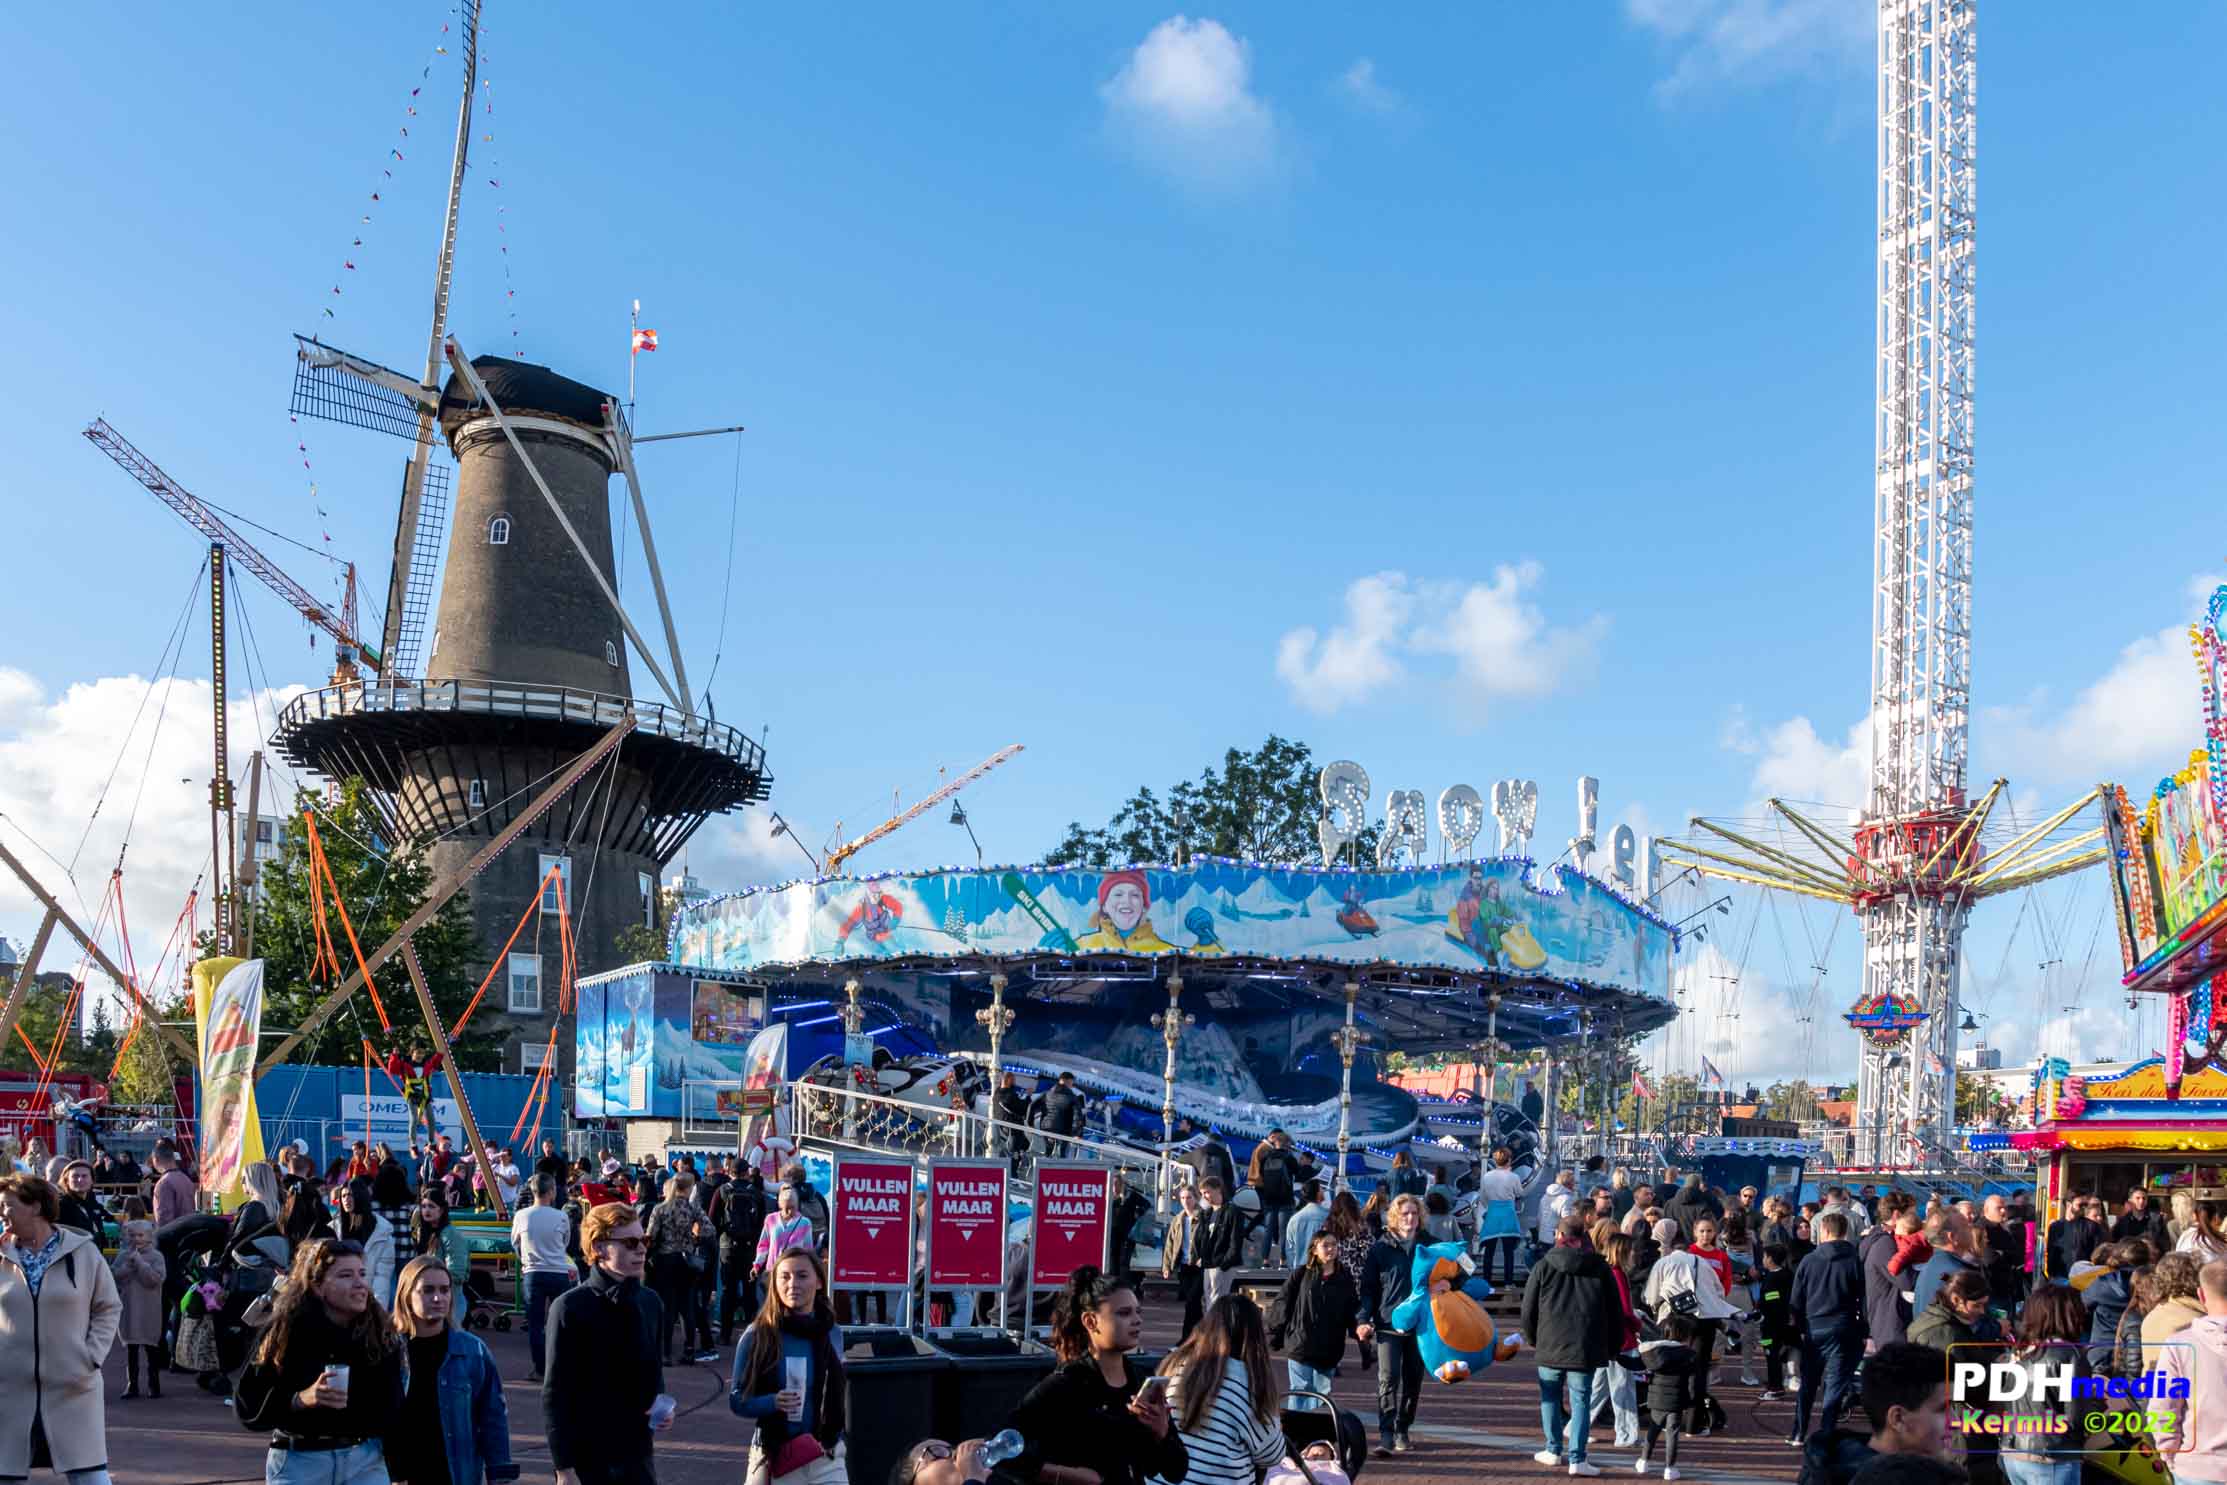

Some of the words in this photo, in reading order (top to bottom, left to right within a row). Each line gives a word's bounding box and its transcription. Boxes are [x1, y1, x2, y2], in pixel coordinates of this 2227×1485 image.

[842, 1177, 908, 1195] VULLEN
[936, 1181, 1000, 1197] VULLEN
[1041, 1183, 1103, 1198] VULLEN
[848, 1197, 900, 1213] MAAR
[943, 1200, 992, 1215] MAAR
[1047, 1201, 1096, 1216] MAAR
